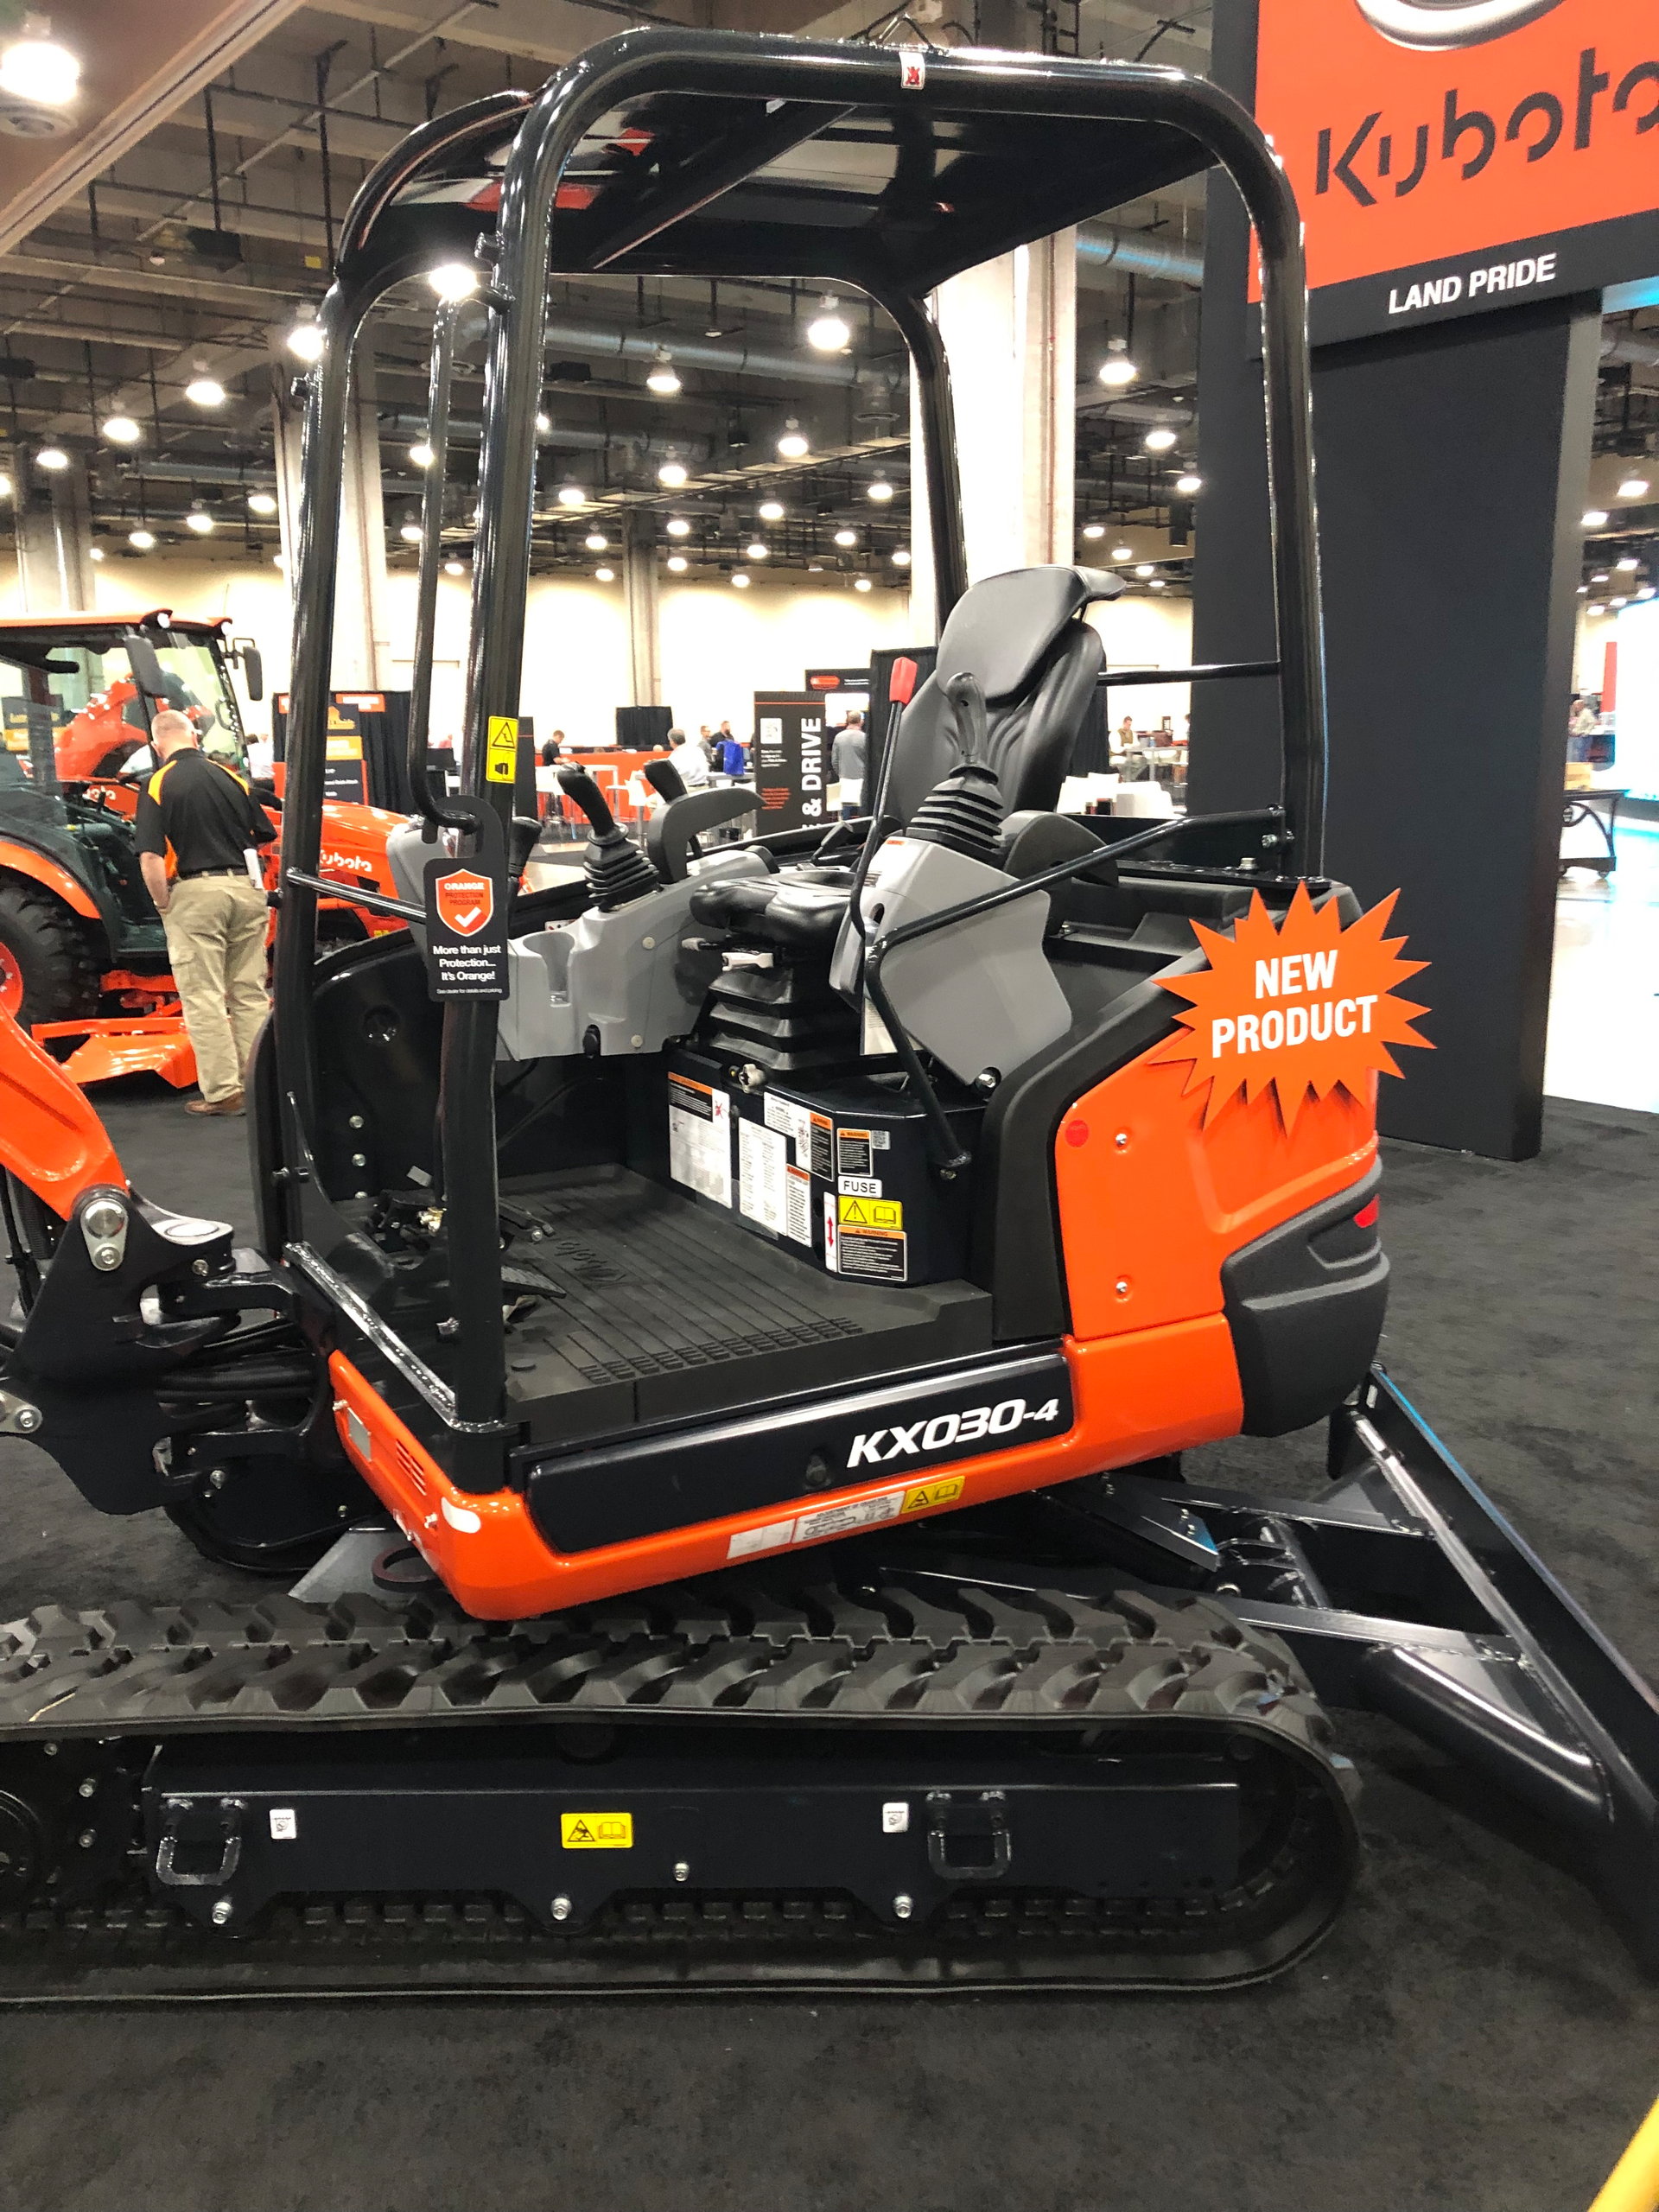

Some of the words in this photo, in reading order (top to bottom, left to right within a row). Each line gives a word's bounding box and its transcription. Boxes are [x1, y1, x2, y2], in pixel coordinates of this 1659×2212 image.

[1315, 47, 1659, 207] Kubota
[1388, 275, 1462, 315] LAND
[1469, 252, 1557, 297] PRIDE
[800, 717, 822, 791] DRIVE
[802, 798, 822, 817] &
[443, 882, 485, 891] ORANGE
[433, 945, 460, 955] More
[460, 944, 482, 954] than
[482, 944, 502, 956] just
[1255, 949, 1338, 1000] NEW
[441, 971, 456, 981] It's
[456, 970, 496, 982] Orange!
[1211, 994, 1379, 1058] PRODUCT
[843, 1180, 876, 1193] FUSE
[846, 1398, 1059, 1468] KX030-4
